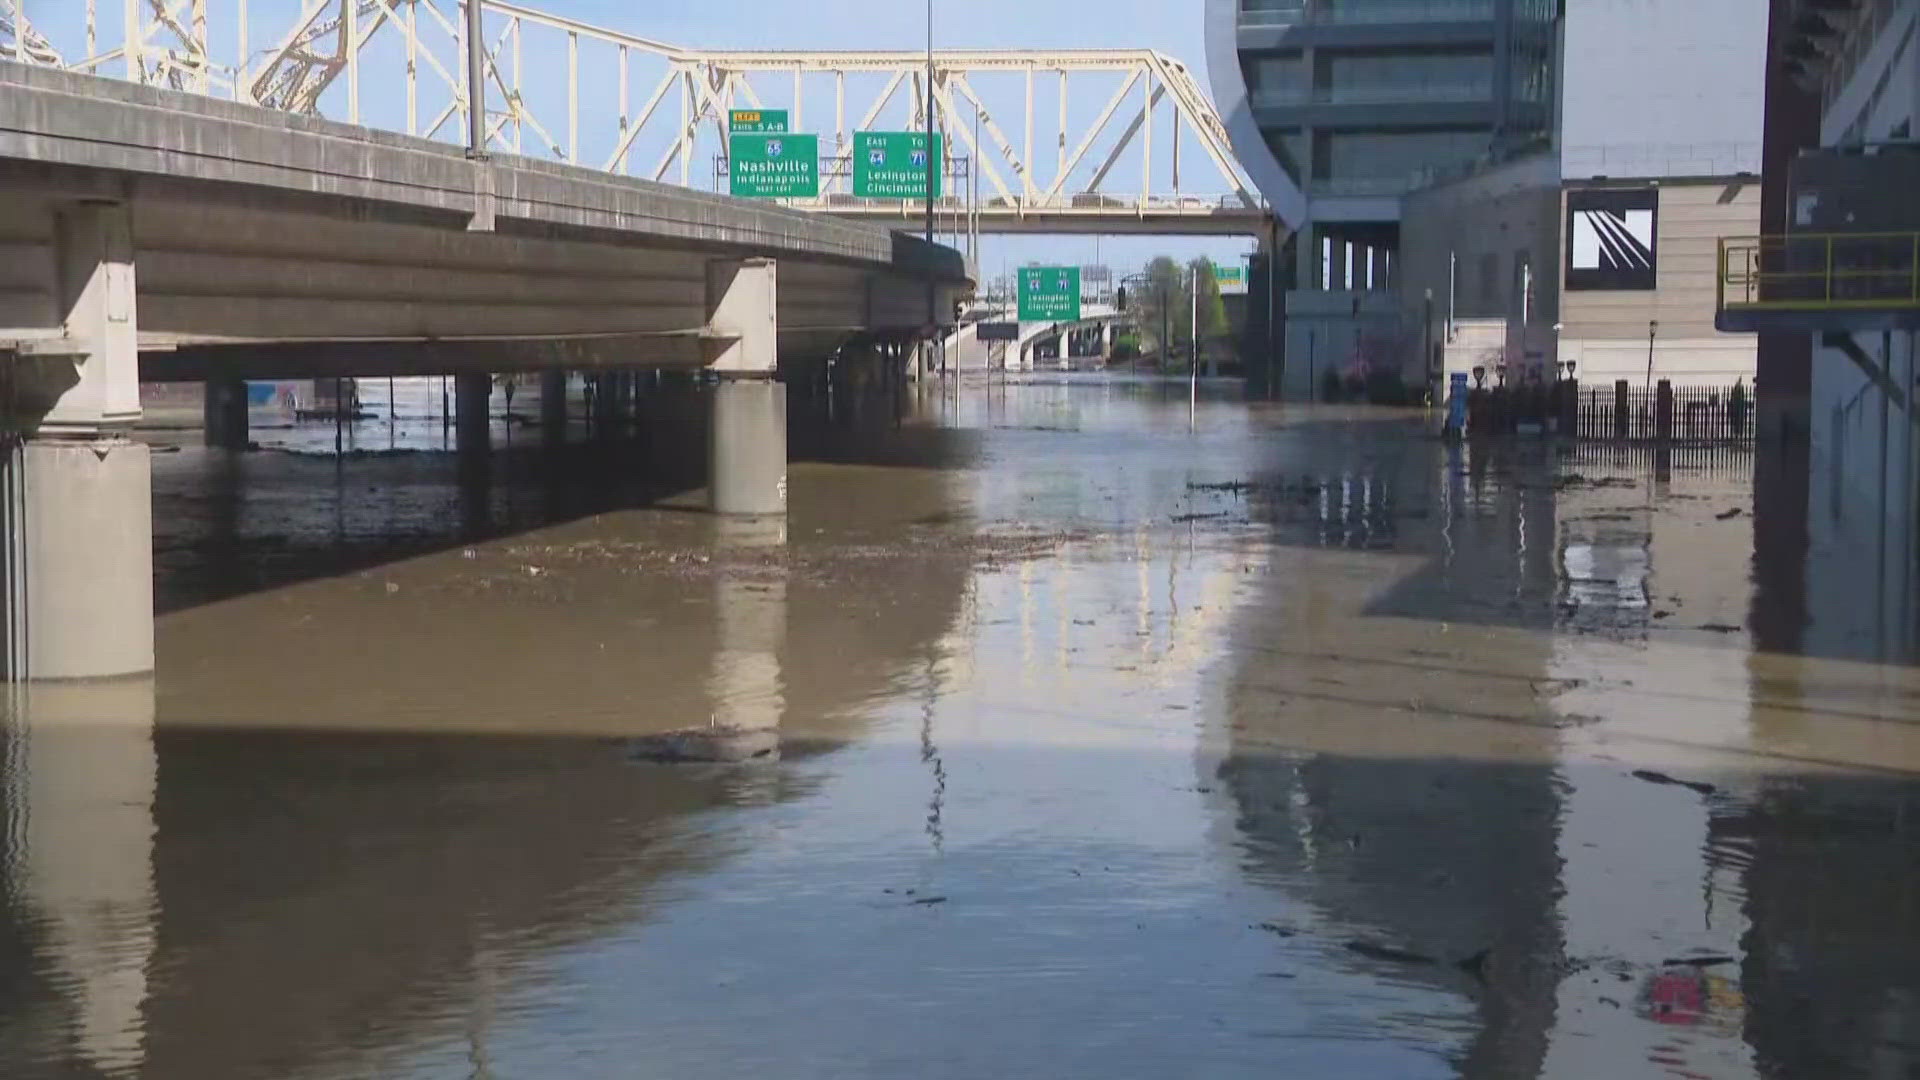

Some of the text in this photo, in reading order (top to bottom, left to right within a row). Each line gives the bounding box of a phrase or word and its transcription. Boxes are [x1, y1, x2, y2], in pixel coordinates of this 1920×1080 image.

[866, 137, 924, 147] EAST TO
[870, 151, 924, 166] 64 71
[739, 160, 809, 172] Nashville
[736, 174, 810, 185] Indianapolis
[867, 170, 926, 182] Lexington
[867, 183, 928, 194] Cincinnati
